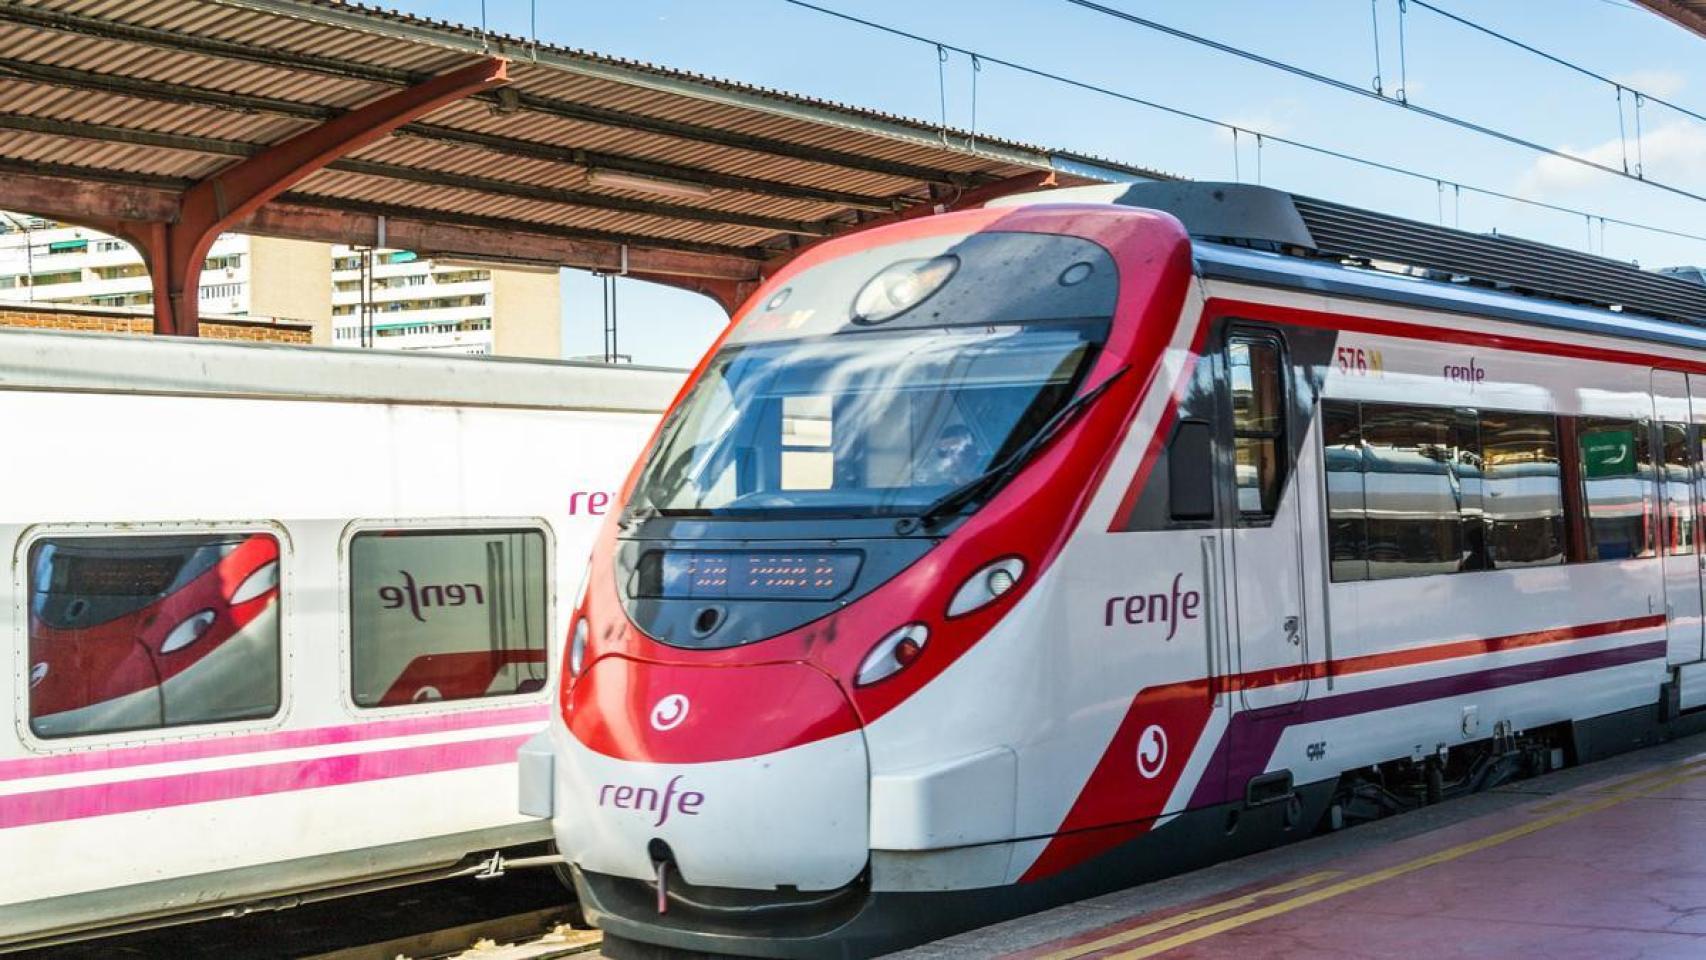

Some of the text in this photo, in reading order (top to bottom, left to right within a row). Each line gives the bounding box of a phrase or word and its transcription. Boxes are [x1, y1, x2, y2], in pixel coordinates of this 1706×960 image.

[1443, 356, 1485, 394] renfe
[569, 491, 616, 516] re
[1104, 572, 1201, 642] renfe
[599, 774, 705, 828] renfe
